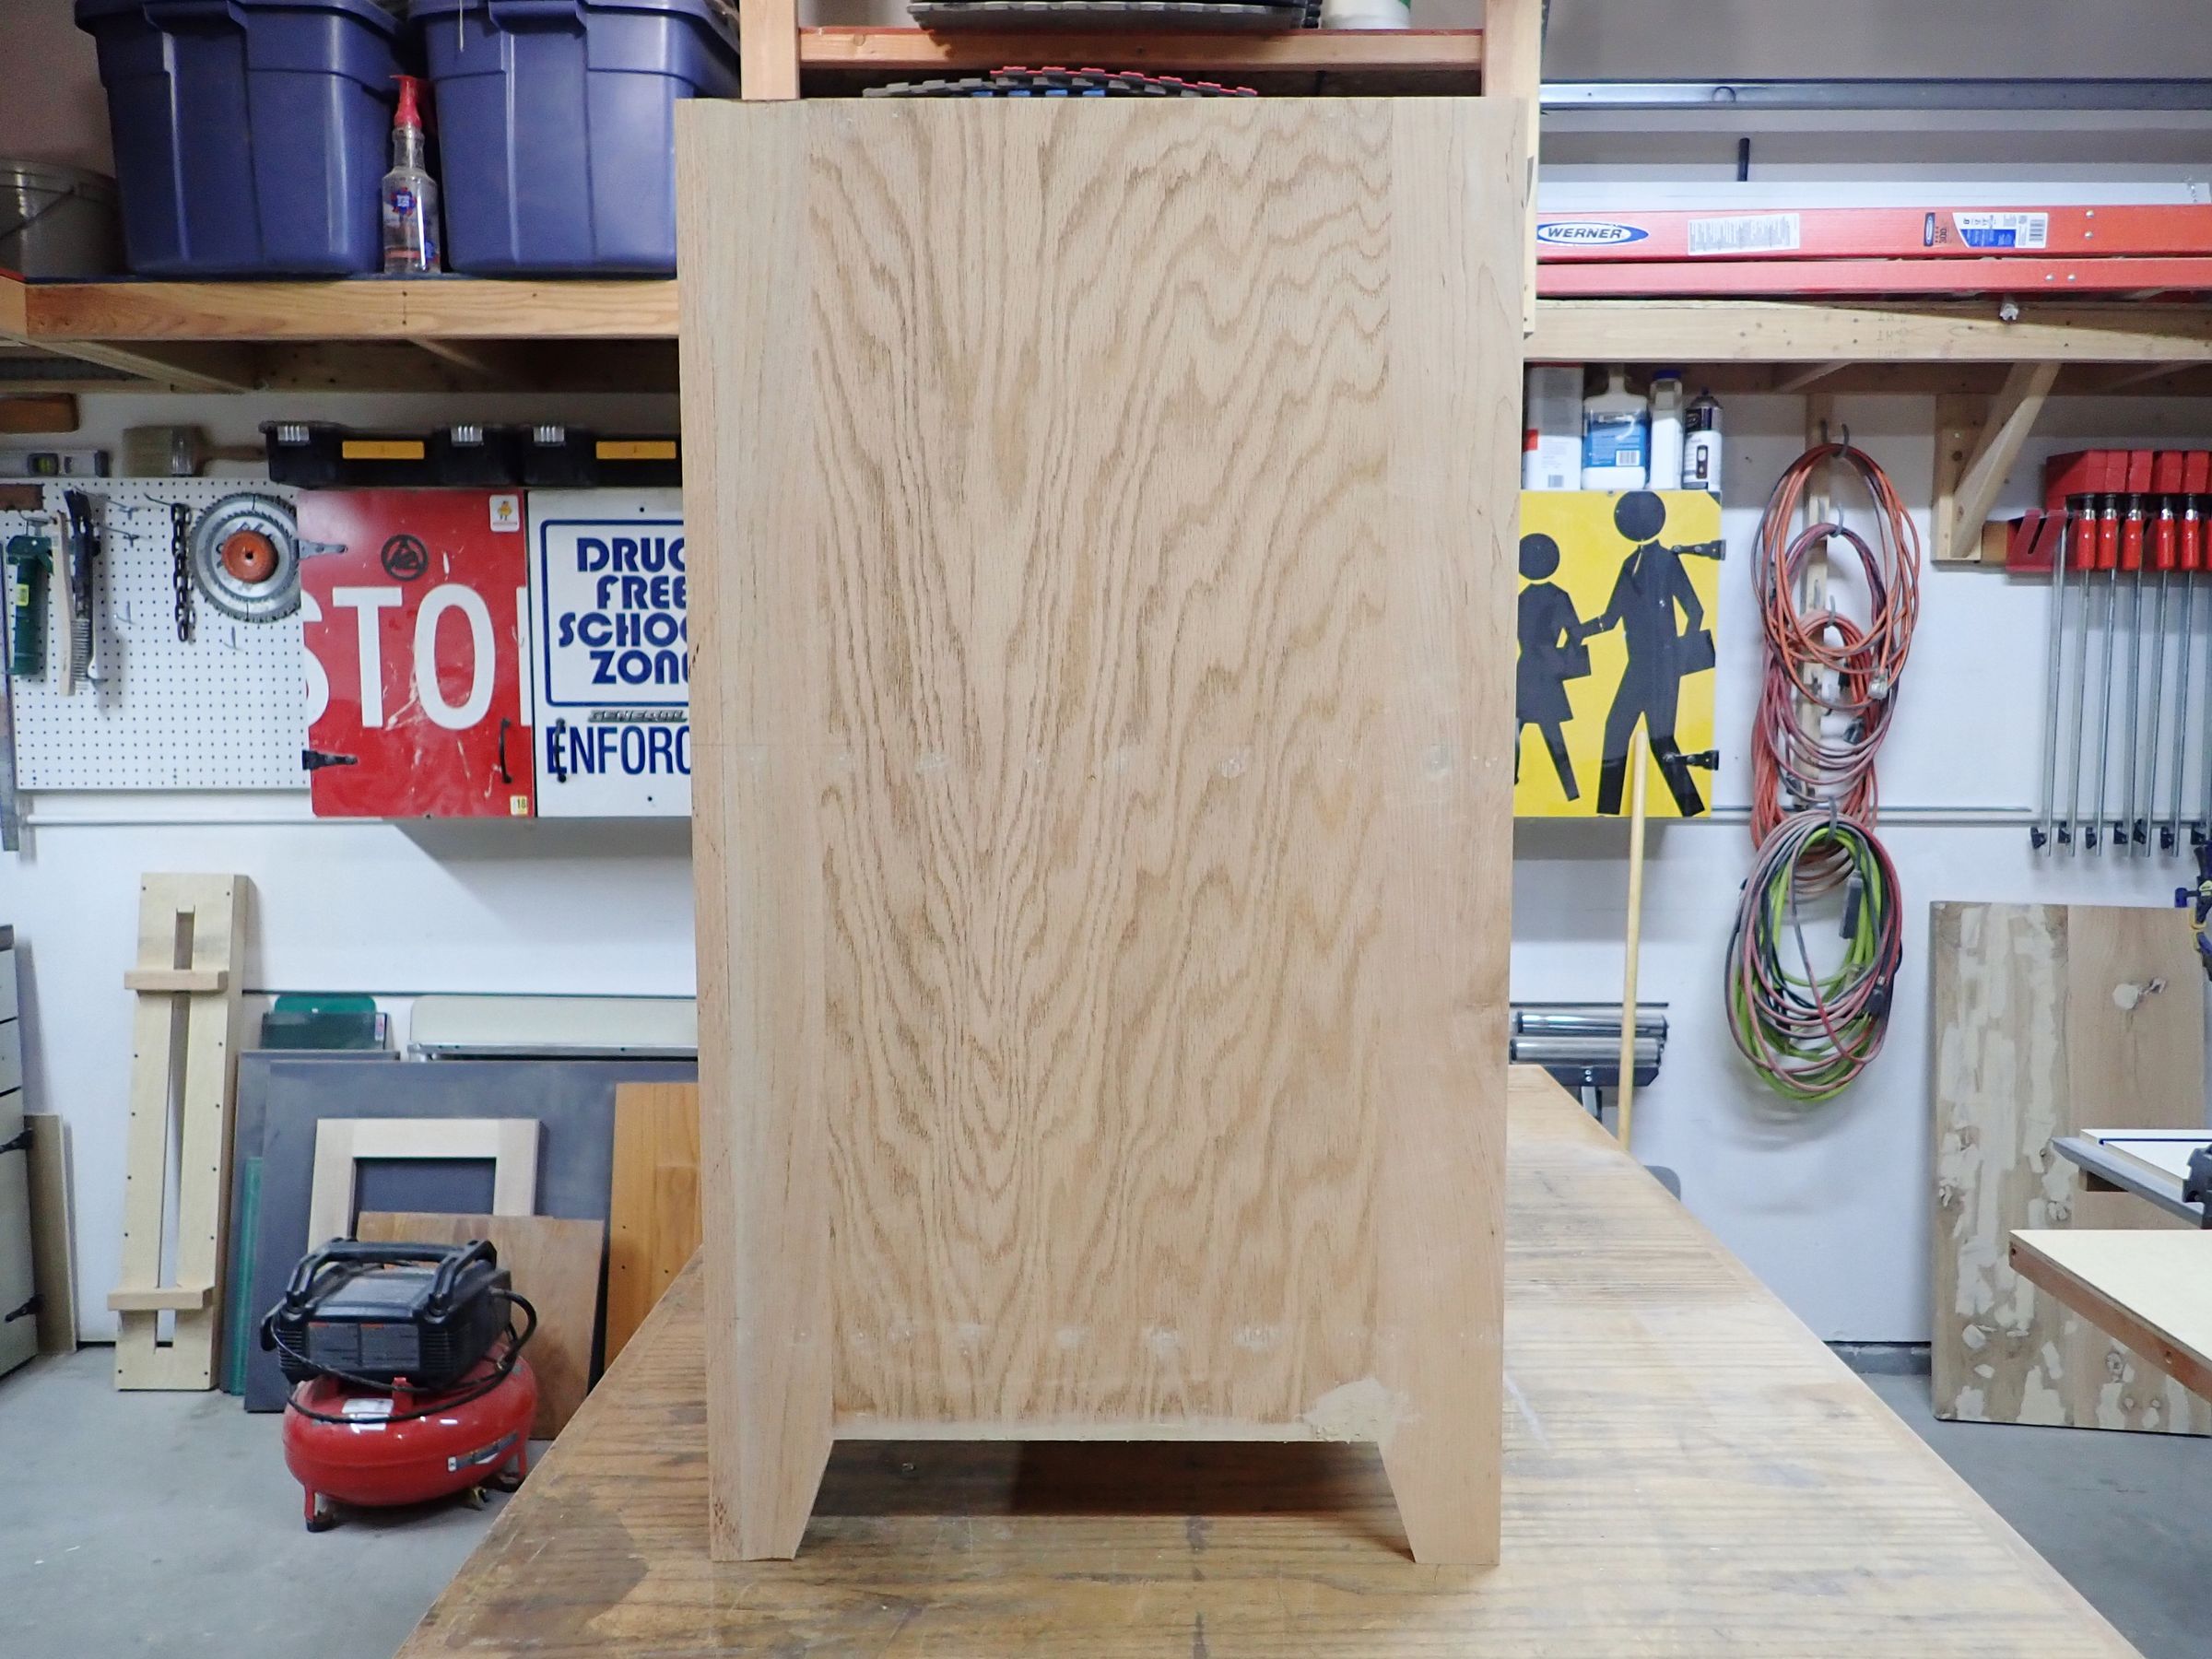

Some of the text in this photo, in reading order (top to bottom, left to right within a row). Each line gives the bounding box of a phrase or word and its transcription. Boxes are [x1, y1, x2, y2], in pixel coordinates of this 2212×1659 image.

[1547, 227, 1623, 240] WERNER
[596, 574, 687, 610] FREE
[559, 612, 688, 648] SCHO
[300, 583, 533, 731] TO
[590, 649, 688, 685] ZON
